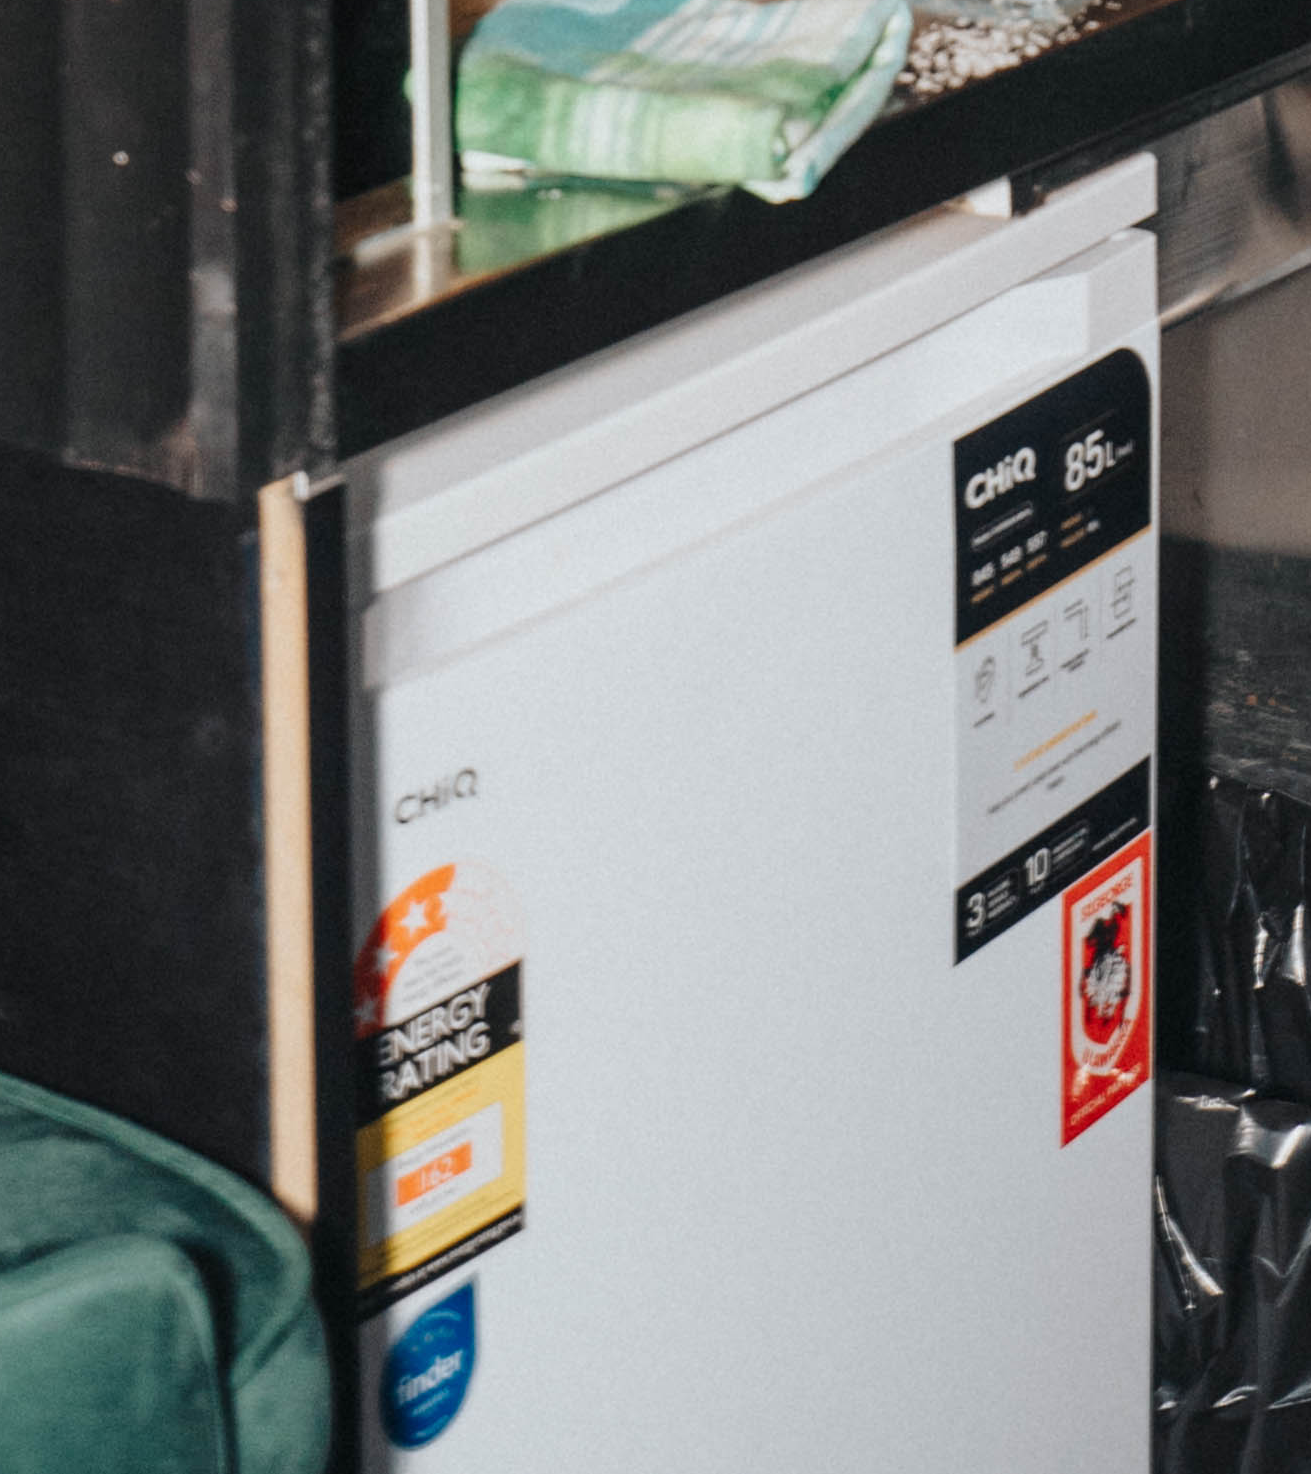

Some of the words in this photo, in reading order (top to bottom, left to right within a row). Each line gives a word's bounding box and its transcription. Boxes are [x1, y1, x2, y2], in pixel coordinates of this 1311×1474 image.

[965, 446, 1037, 510] CHiQ
[1024, 847, 1051, 887] 10
[378, 981, 490, 1066] ENERGY
[380, 1020, 490, 1100] RATING
[396, 1348, 464, 1406] finder
